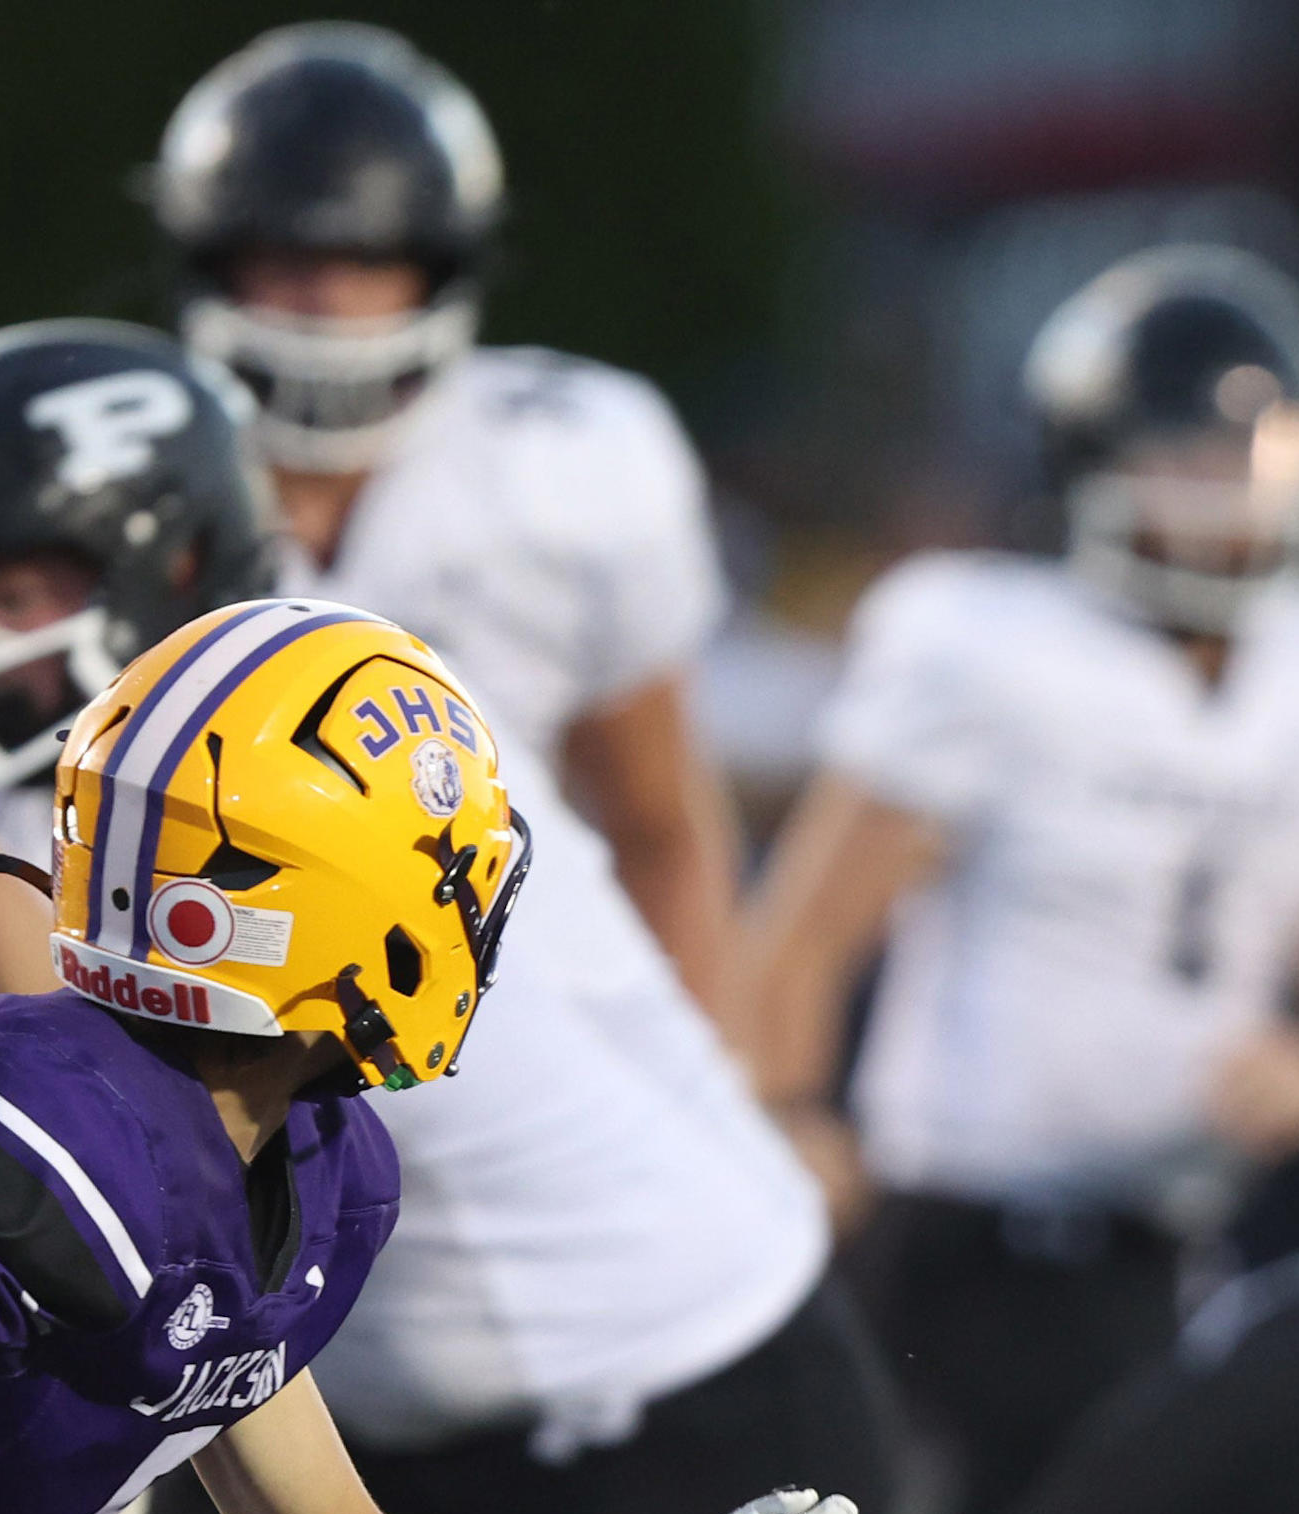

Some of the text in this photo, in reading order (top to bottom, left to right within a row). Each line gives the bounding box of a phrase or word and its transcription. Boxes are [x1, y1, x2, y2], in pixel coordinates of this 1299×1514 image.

[24, 368, 193, 488] P
[353, 686, 478, 758] JHS
[59, 944, 212, 1025] Riddell
[129, 1340, 287, 1422] JACKSON
